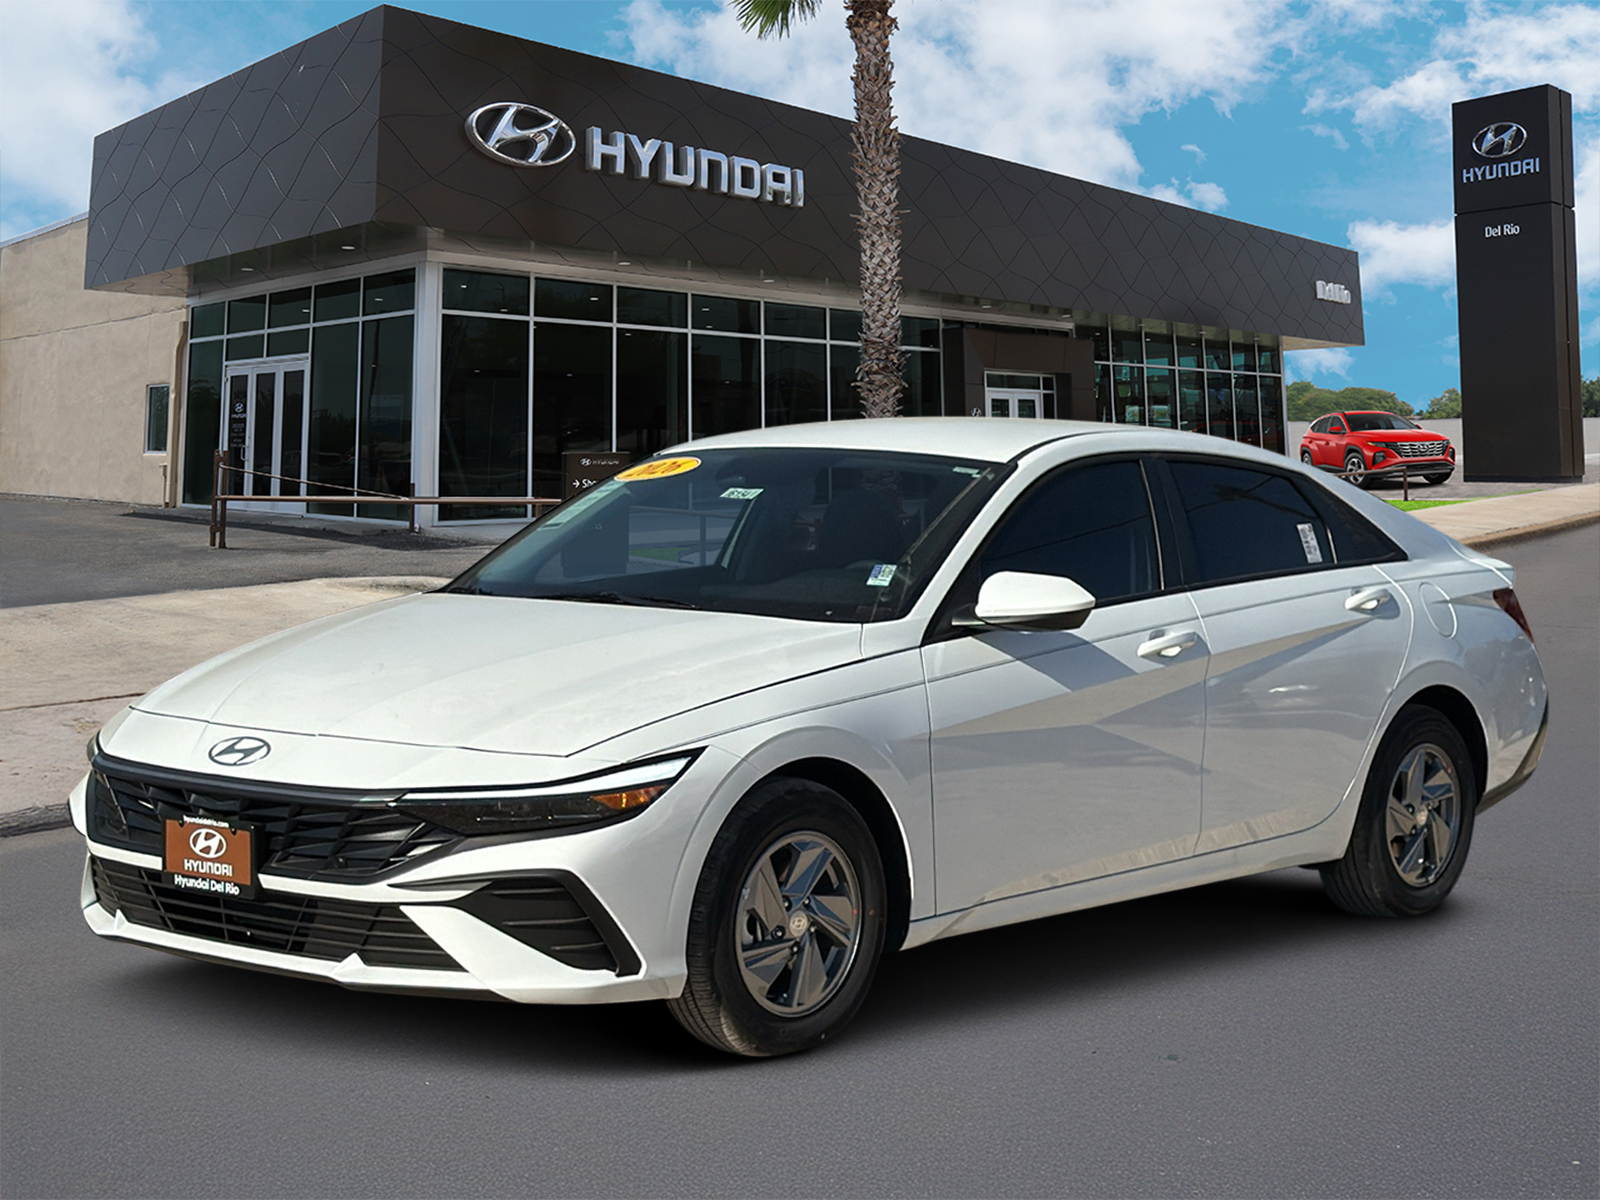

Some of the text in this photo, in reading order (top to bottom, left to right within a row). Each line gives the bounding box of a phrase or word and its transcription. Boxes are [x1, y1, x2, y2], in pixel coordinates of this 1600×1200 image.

[585, 126, 804, 207] HYUNDAI
[1462, 157, 1540, 183] HYUNDAI
[1485, 223, 1520, 238] Del Rio
[184, 859, 232, 876] HYUNDAI
[174, 874, 240, 896] Hyundai Del Rio
